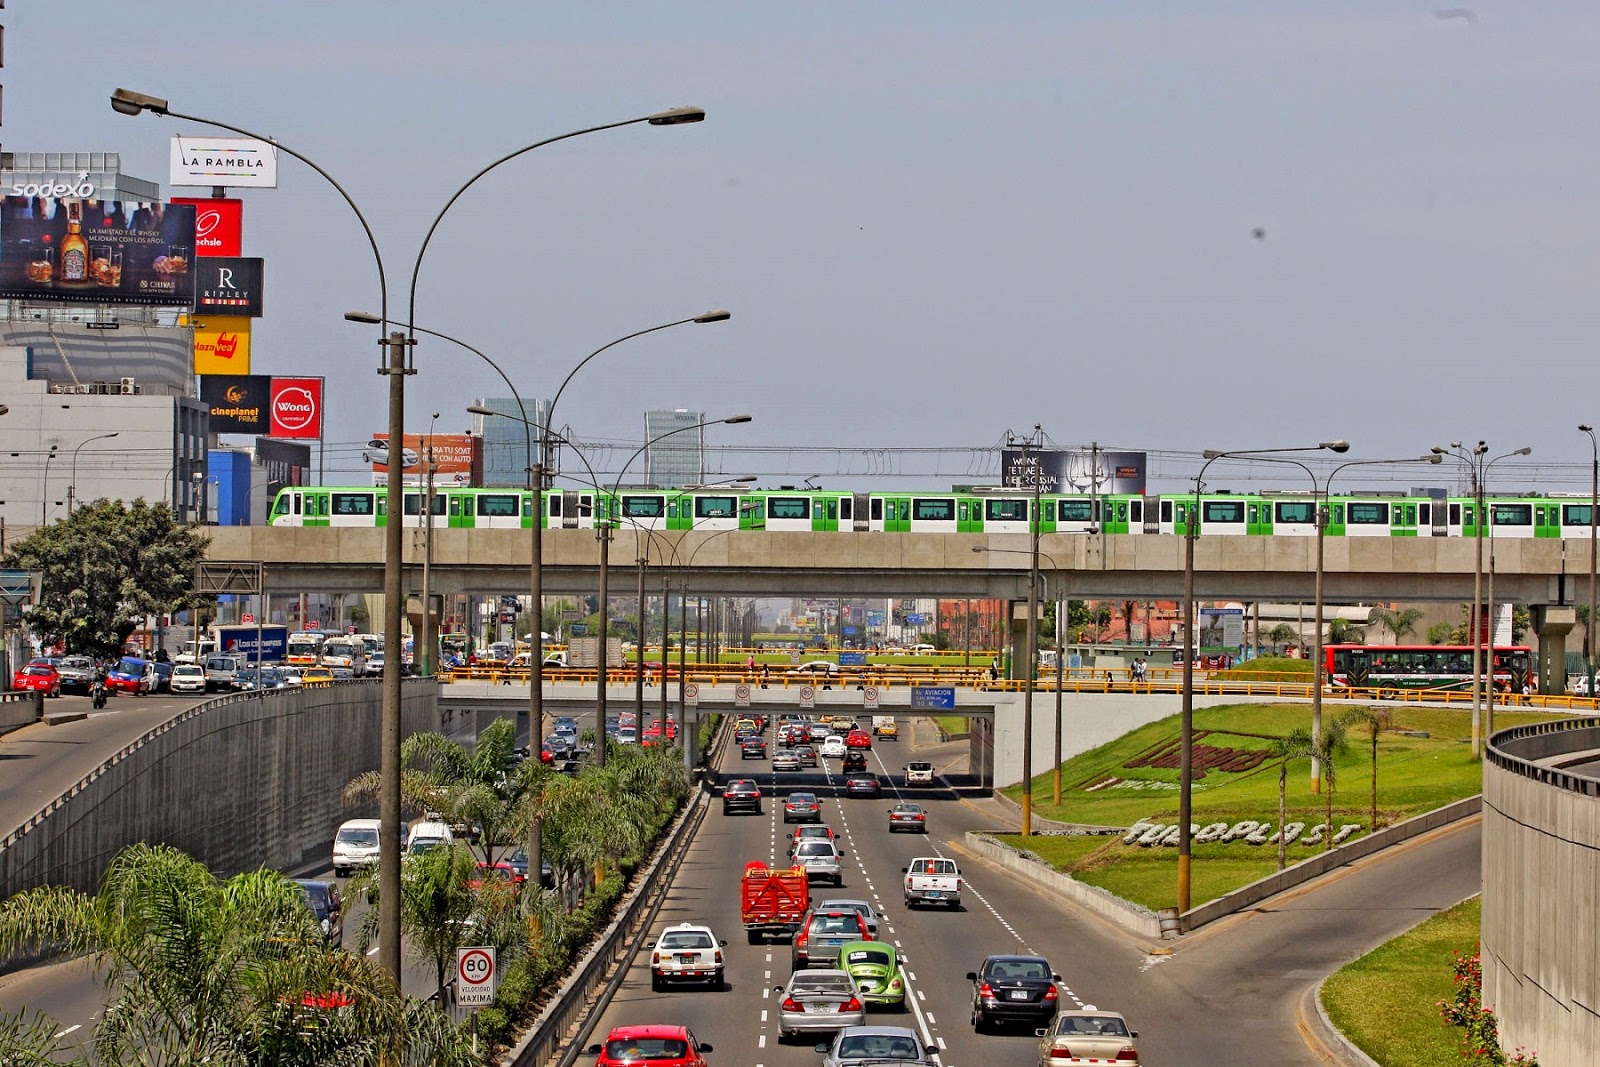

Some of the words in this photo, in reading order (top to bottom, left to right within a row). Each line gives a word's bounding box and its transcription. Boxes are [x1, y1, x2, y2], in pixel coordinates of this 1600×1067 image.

[182, 157, 199, 166] LA
[205, 157, 264, 168] RAMBLA
[10, 178, 94, 198] sodexo
[195, 237, 223, 248] echsle
[218, 267, 237, 290] R
[150, 281, 176, 289] CHIVAS
[204, 290, 249, 299] RIPLEY
[210, 407, 259, 418] cineplanet
[238, 415, 259, 423] PRIME
[454, 447, 471, 455] SOAT
[439, 454, 452, 462] CON
[454, 455, 471, 463] AUTO
[251, 637, 282, 648] cineros
[466, 959, 488, 972] 80
[461, 985, 491, 993] VELOCIDAD
[459, 994, 492, 1003] MAXIMA
